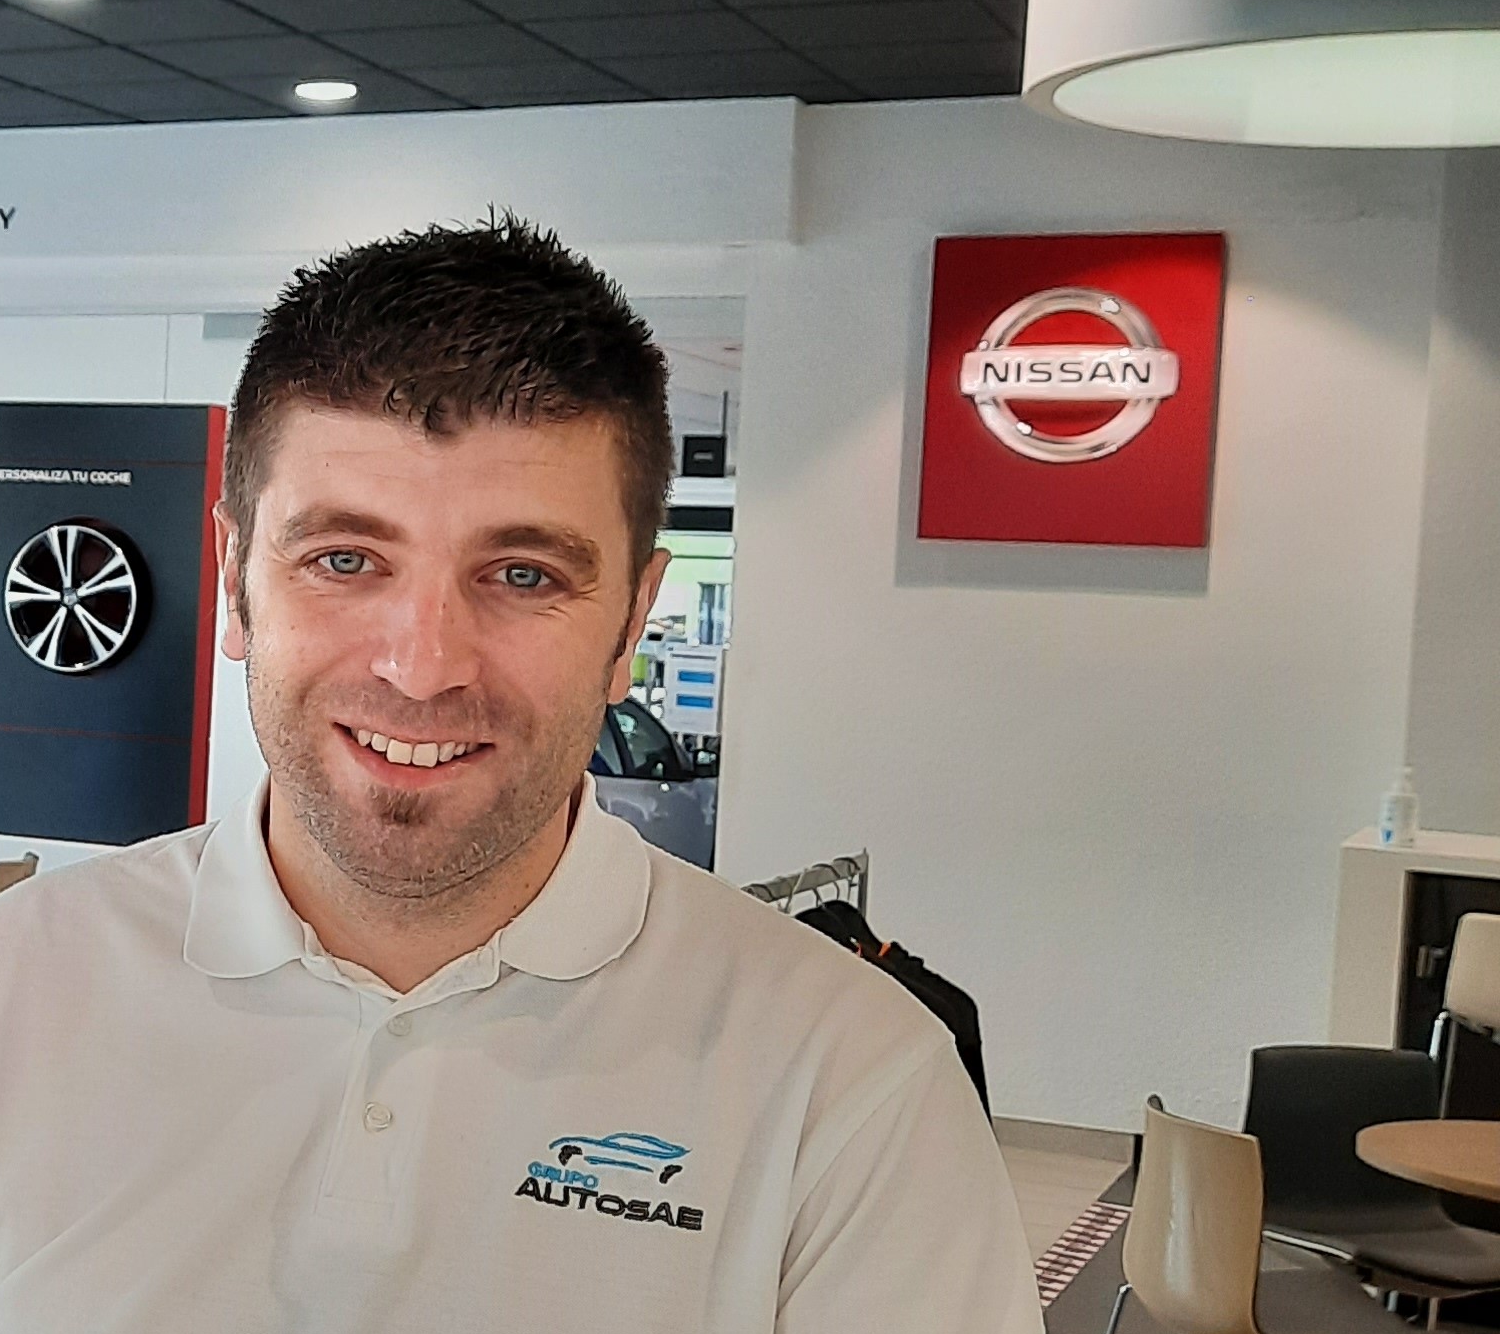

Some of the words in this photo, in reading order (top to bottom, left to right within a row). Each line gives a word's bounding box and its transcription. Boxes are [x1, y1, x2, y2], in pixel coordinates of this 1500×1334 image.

[982, 362, 1151, 383] NISSAN
[71, 470, 88, 484] TU
[90, 471, 132, 486] COCHE
[528, 1162, 599, 1188] GRUPO
[515, 1177, 704, 1231] AUTOSAE
